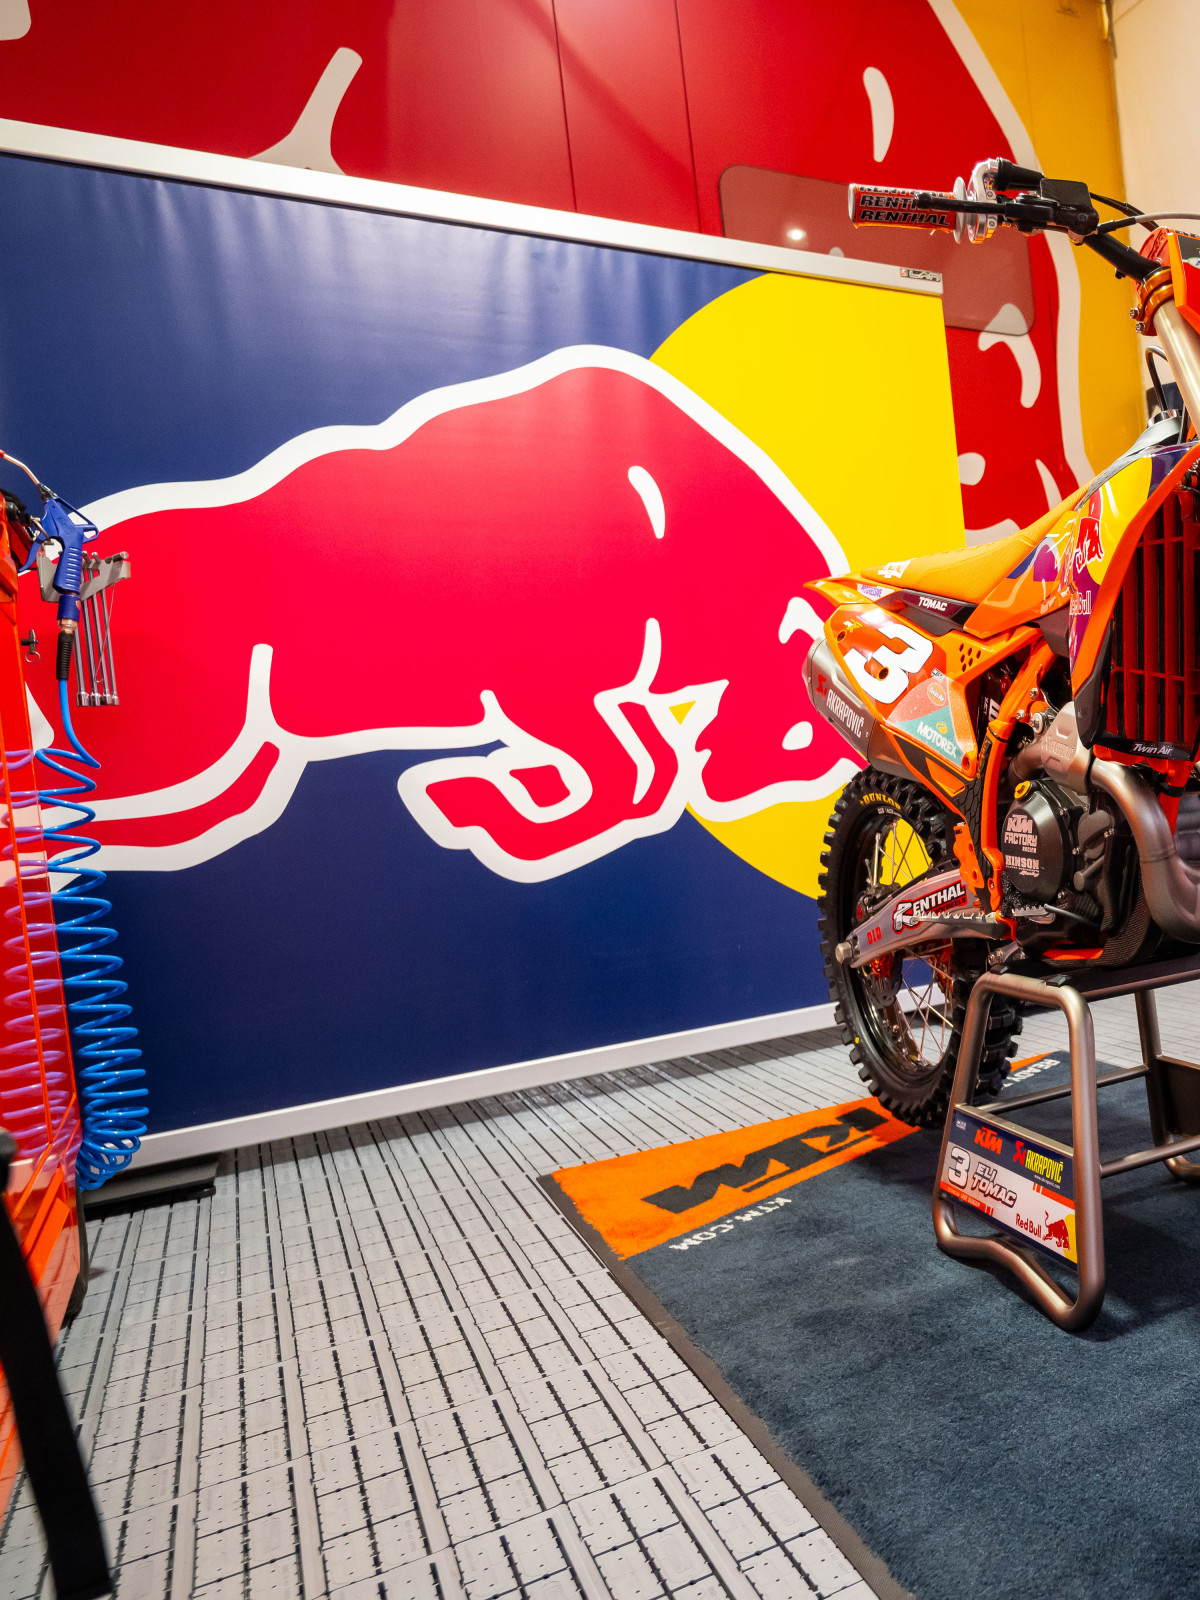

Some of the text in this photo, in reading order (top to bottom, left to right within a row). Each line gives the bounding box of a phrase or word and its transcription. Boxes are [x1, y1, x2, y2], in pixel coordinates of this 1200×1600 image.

[859, 209, 950, 226] RENTHAL
[918, 597, 948, 612] TOMAC
[1078, 590, 1092, 615] Bull
[843, 623, 934, 704] 3
[916, 721, 957, 759] MOTOREX
[1133, 743, 1173, 755] Twin Air
[1006, 814, 1033, 834] KTM
[1004, 831, 1038, 847] FACTORY
[1005, 854, 1039, 870] HINSON
[893, 882, 966, 932] RENTHAL
[866, 926, 882, 945] DID
[973, 1126, 1003, 1155] KTM
[948, 1145, 970, 1189] 3
[975, 1161, 998, 1182] ELI
[971, 1173, 1018, 1208] TOMAC
[669, 1197, 792, 1250] KTM.COM
[1015, 1213, 1042, 1239] Red Bull
